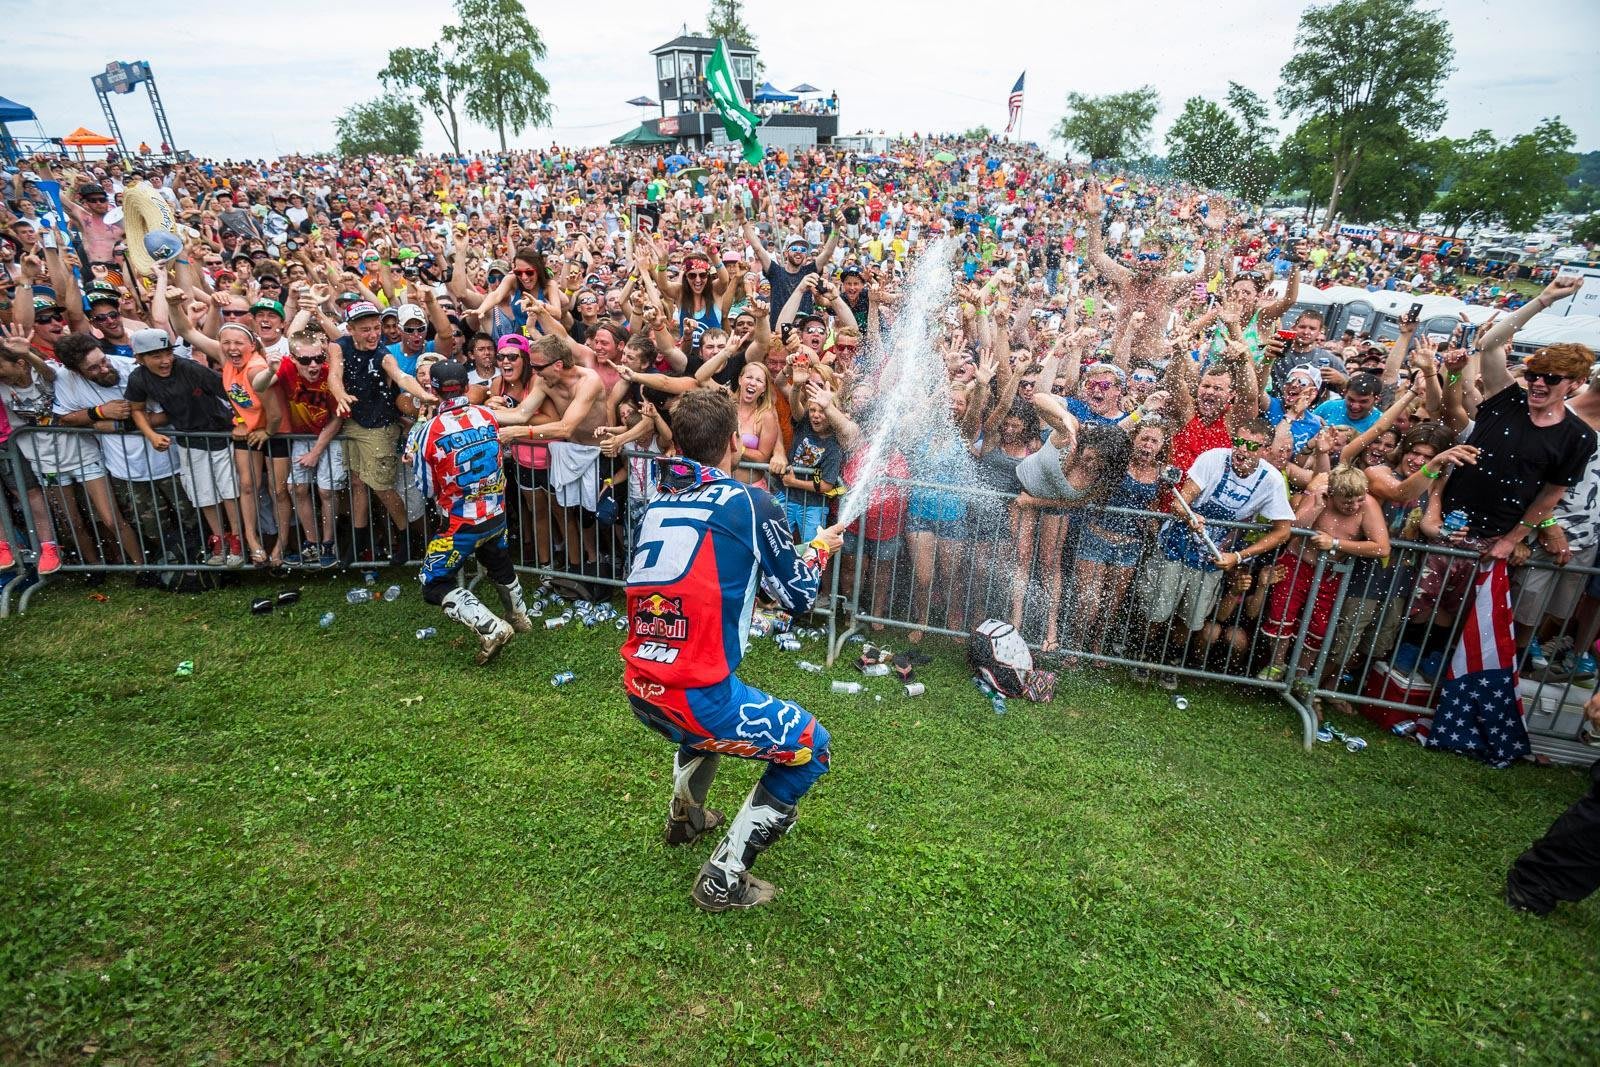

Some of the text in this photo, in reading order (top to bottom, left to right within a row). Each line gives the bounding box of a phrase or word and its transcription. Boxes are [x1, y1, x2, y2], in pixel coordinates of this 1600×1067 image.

[1340, 226, 1379, 237] PARTS
[454, 440, 500, 487] 3
[627, 507, 714, 584] 5
[764, 528, 780, 557] ATHENA
[635, 616, 686, 638] Red Bull
[632, 641, 680, 664] KTM
[689, 738, 765, 758] KTM
